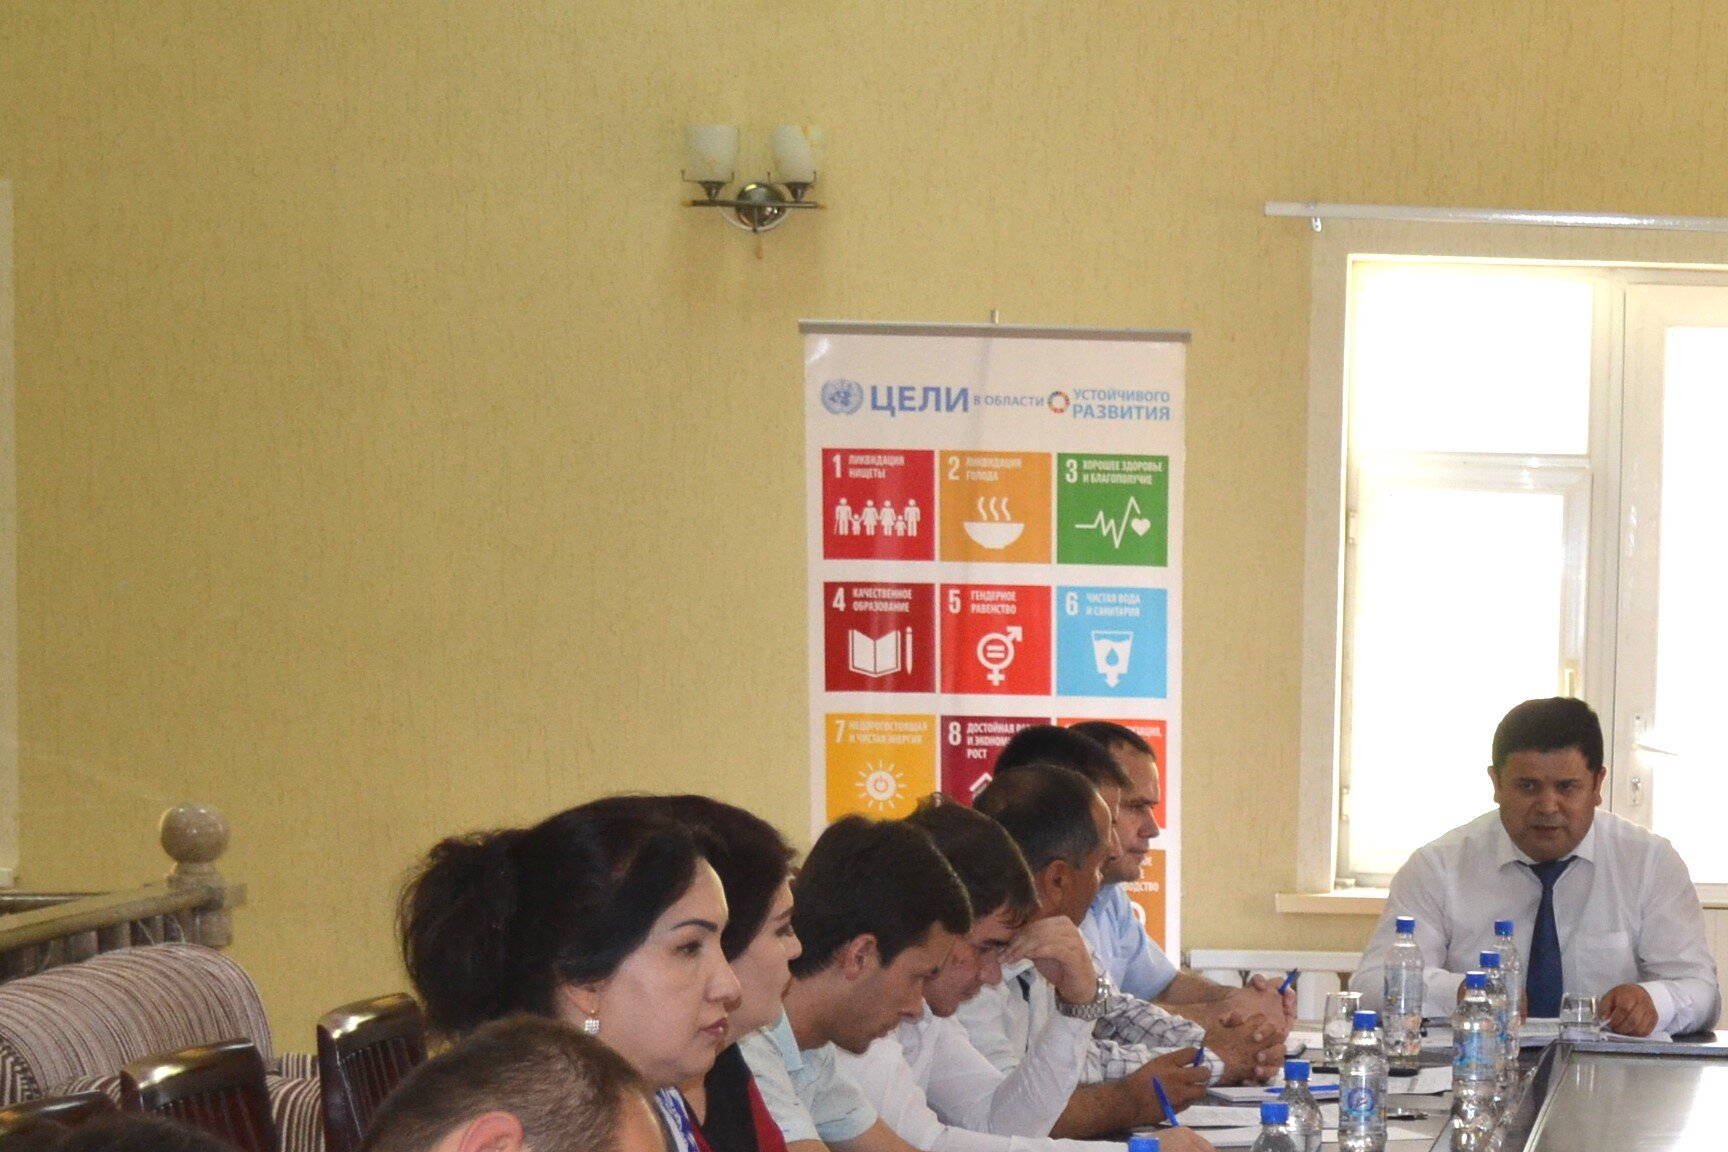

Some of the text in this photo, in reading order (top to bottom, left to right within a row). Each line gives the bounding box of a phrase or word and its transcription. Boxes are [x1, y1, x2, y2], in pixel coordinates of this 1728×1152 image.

[870, 384, 1045, 417] ЦЕЛИ В ОБЛАСТИ
[1072, 388, 1170, 403] УСТОЙЧИВОГО
[1072, 403, 1171, 421] РАЗВИТИЯ
[832, 454, 842, 478] 1
[948, 455, 960, 480] 2
[1065, 458, 1078, 483] 3
[1083, 460, 1163, 473] ХОРОШЕЕ ЗДОРОВЬЕ
[832, 587, 846, 612] 4
[852, 588, 913, 600] КАЧЕСТВЕННОЕ
[948, 589, 961, 614] 5
[971, 590, 1016, 602] ГЕНДЕРНОЕ
[1065, 591, 1079, 616] 6
[852, 601, 910, 613] ОБРАЗОВАНИЕ
[971, 603, 1017, 615] РАВЕНСТВО
[835, 719, 846, 744] 7
[948, 721, 962, 746] 8
[967, 722, 1015, 735] ДОСТОЙНАЯ
[967, 748, 987, 760] РОСТ
